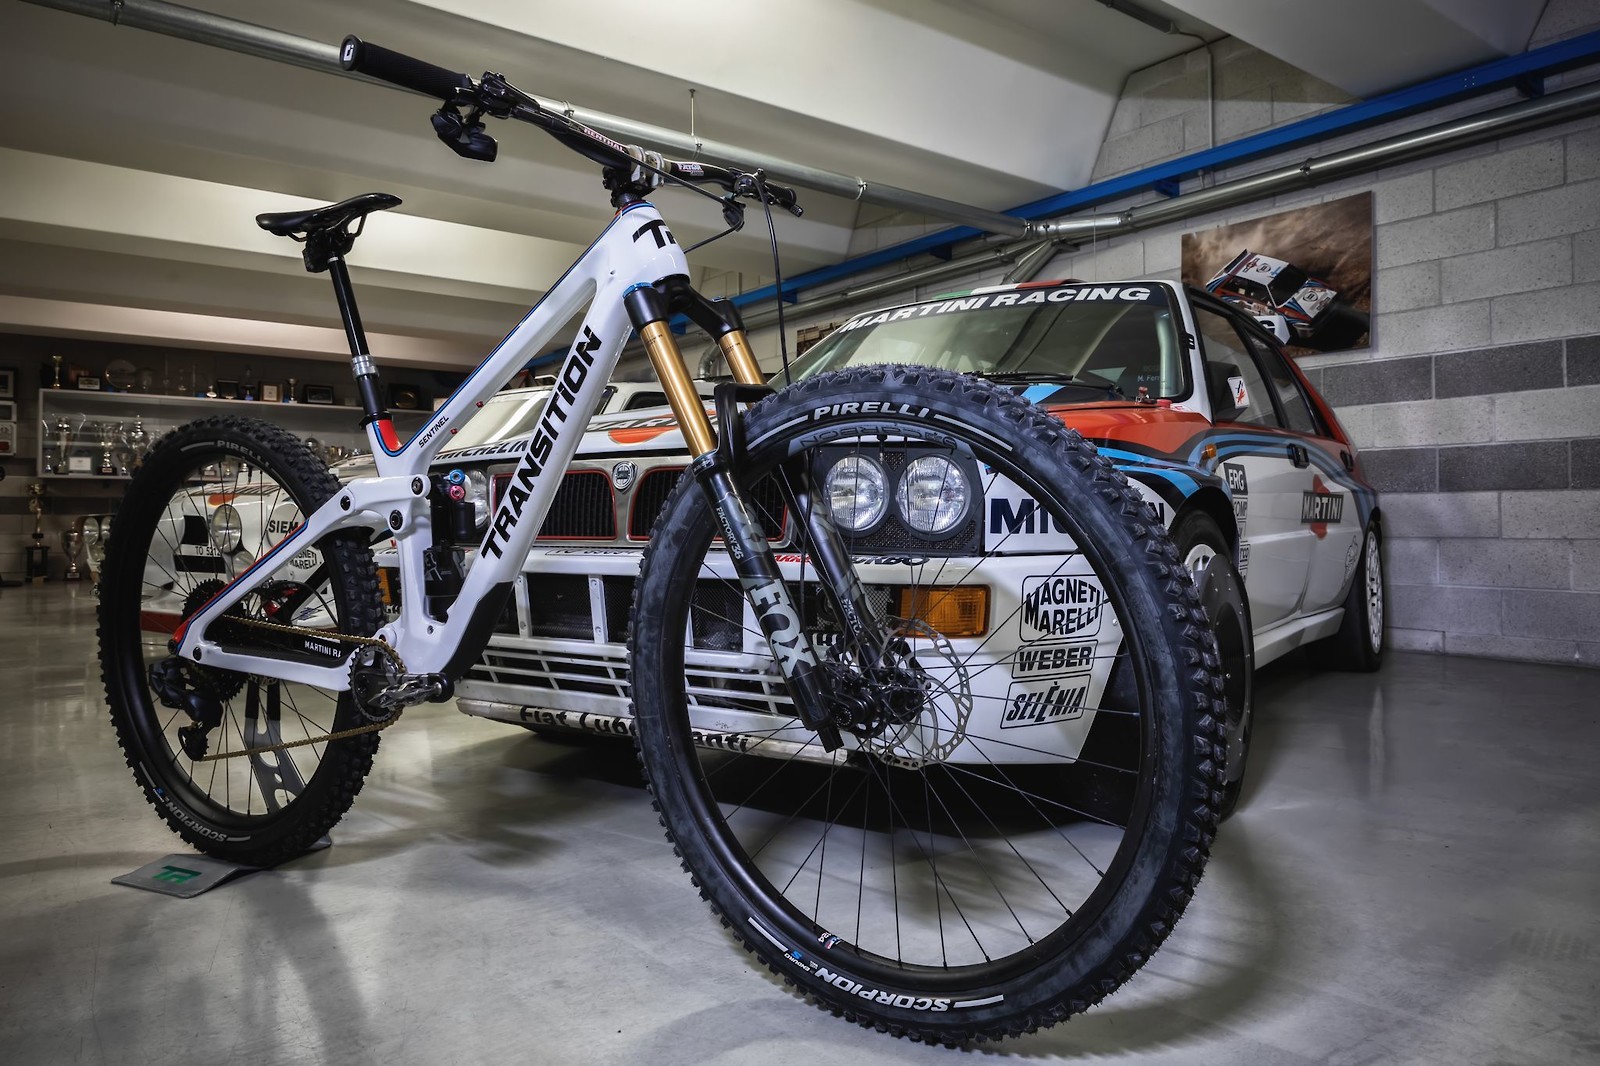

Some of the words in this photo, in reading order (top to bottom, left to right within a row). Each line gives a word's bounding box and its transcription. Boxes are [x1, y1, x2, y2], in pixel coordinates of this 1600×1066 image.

[840, 296, 993, 333] MARTINI
[992, 287, 1152, 306] RACING
[813, 401, 930, 421] PIRELLI
[418, 415, 449, 448] SENTINEL
[482, 325, 602, 560] TRANSITION
[1228, 469, 1244, 491] ERG
[1302, 497, 1343, 520] MARTINI
[268, 519, 301, 534] SIEM
[716, 506, 738, 545] FACTORY
[731, 543, 744, 560] 36
[1025, 578, 1101, 612] MAGNETI
[749, 578, 817, 679] FOX
[1024, 604, 1100, 636] MARELLI
[304, 640, 332, 656] MARTINI
[1018, 646, 1092, 672] WEBER
[520, 706, 567, 727] Fiat
[165, 801, 227, 842] SCORPION
[814, 967, 951, 1012] SCORPION
